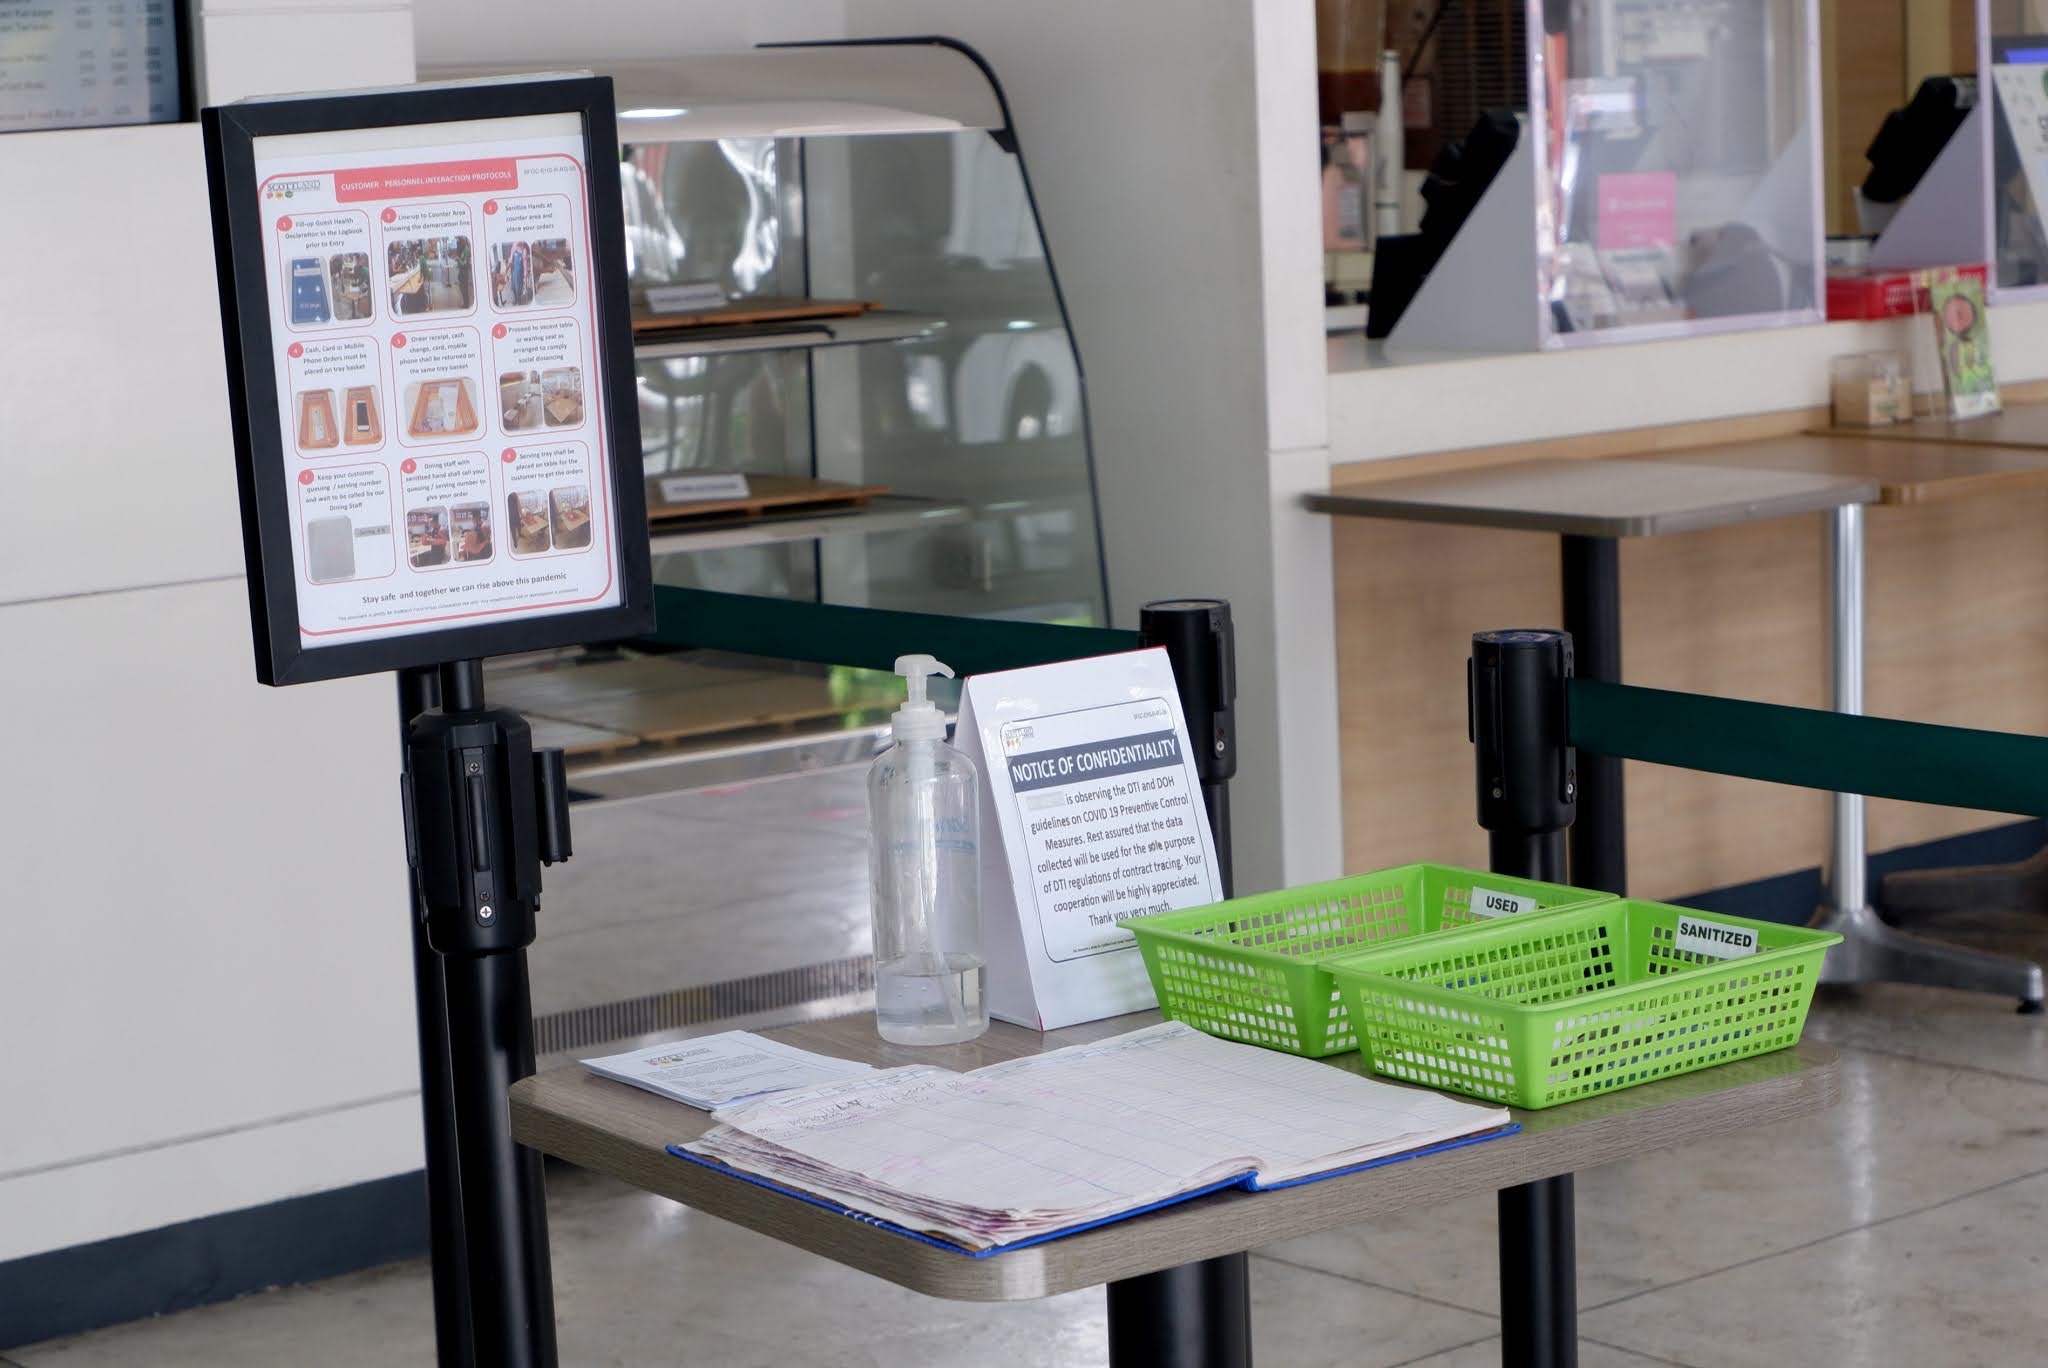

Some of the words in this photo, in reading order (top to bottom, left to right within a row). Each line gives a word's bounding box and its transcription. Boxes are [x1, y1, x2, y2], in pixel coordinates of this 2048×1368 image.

[341, 181, 379, 191] CUSTOMER
[385, 179, 424, 187] PERSONNEL
[425, 174, 470, 183] INTERACTION
[472, 172, 512, 180] PROTOCOLS
[295, 219, 315, 227] Fill-up
[384, 224, 411, 233] following
[423, 220, 458, 229] demarcation
[506, 224, 521, 233] place
[285, 230, 319, 239] Declaration
[338, 228, 363, 236] Logbook
[306, 241, 320, 249] prior
[344, 342, 365, 350] Mobile
[547, 343, 567, 351] comply
[519, 356, 535, 364] social
[536, 354, 564, 362] distancing
[437, 365, 448, 373] tray
[520, 452, 540, 460] Serving
[516, 463, 534, 471] placed
[318, 473, 333, 481] Keep
[348, 470, 374, 478] customer
[406, 474, 431, 482] sanitized
[511, 473, 536, 481] customer
[307, 484, 330, 493] queuing
[359, 479, 382, 487] number
[407, 485, 429, 493] queuing
[435, 482, 455, 490] serving
[457, 479, 478, 487] number
[348, 491, 365, 499] called
[366, 490, 374, 498] by
[362, 594, 379, 604] Stay
[381, 592, 396, 602] safe
[400, 589, 414, 599] and
[415, 585, 447, 598] together
[449, 585, 460, 593] we
[462, 583, 475, 592] can
[477, 580, 491, 589] rise
[492, 578, 515, 588] above
[516, 576, 530, 586] this
[531, 572, 567, 583] pandemic
[1012, 759, 1056, 782] NOTICE
[1058, 756, 1074, 775] OF
[1077, 739, 1175, 772] CONFIDENTIALITY
[1066, 795, 1073, 805] is
[1075, 788, 1112, 804] observing
[1113, 785, 1126, 797] the
[1128, 781, 1140, 794] DTI
[1142, 778, 1155, 791] and
[1157, 776, 1174, 789] DOH
[1031, 816, 1070, 834] guidelines
[1072, 816, 1081, 825] on
[1083, 808, 1108, 822] COVID
[1111, 806, 1118, 818] 19
[1120, 799, 1159, 816] Preventive
[1160, 794, 1189, 807] Control
[1045, 834, 1085, 851] Measures.
[1087, 831, 1104, 843] Rest
[1105, 824, 1134, 839] assured
[1135, 822, 1150, 833] that
[1152, 819, 1164, 830] the
[1165, 816, 1183, 828] data
[1037, 856, 1072, 873] collected
[1074, 853, 1088, 866] will
[1090, 851, 1099, 863] be
[1102, 847, 1119, 861] used
[1121, 845, 1132, 857] for
[1134, 843, 1146, 854] the
[1164, 835, 1195, 849] purpose
[1043, 882, 1052, 893] of
[1054, 878, 1066, 891] DTI
[1068, 872, 1111, 890] regulations
[1113, 868, 1121, 879] of
[1122, 862, 1152, 878] contract
[1154, 857, 1183, 872] tracing.
[1184, 854, 1201, 865] Your
[1054, 895, 1100, 913] cooperation
[1101, 891, 1115, 902] will
[1116, 889, 1126, 900] be
[1127, 884, 1150, 899] highly
[1152, 875, 1200, 893] appreciated.
[1485, 895, 1519, 914] USED
[1089, 911, 1113, 926] Thank
[1114, 909, 1128, 922] you
[1130, 908, 1147, 918] very
[1150, 900, 1172, 915] much.
[1679, 921, 1753, 949] SANITIZED
